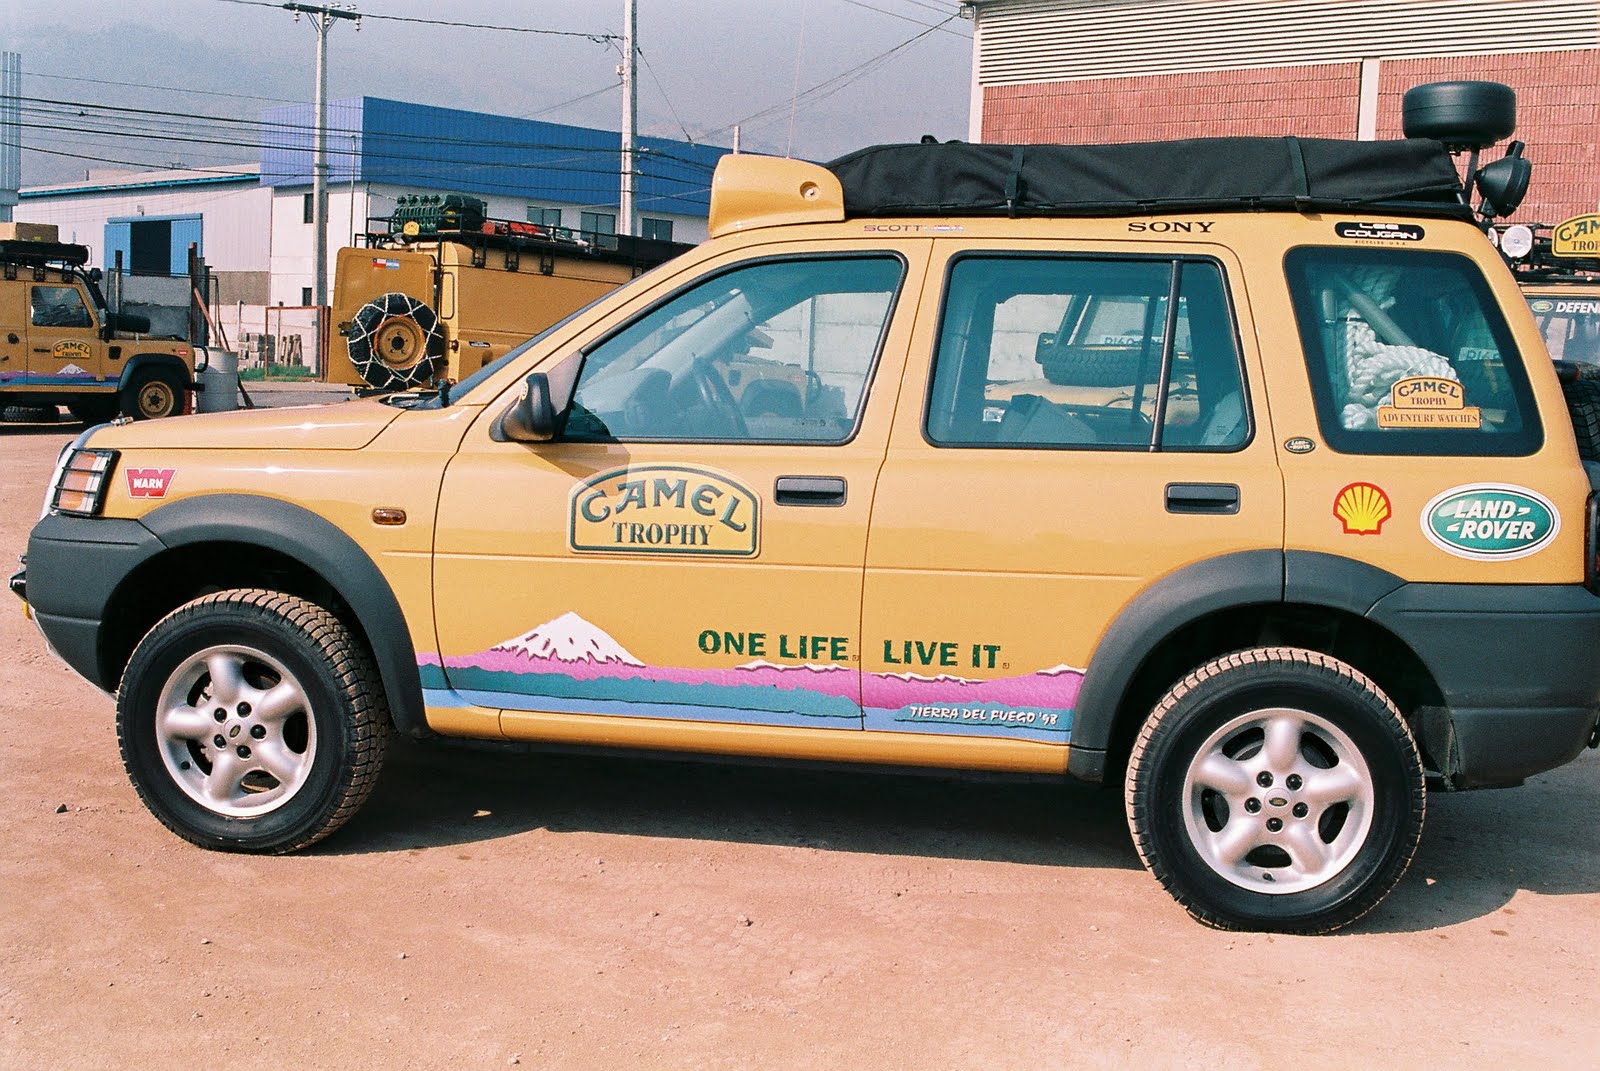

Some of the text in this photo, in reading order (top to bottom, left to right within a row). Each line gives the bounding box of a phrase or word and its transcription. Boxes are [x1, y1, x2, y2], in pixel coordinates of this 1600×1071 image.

[864, 224, 922, 232] SCOTT
[1128, 221, 1215, 233] SONY
[1560, 219, 1600, 241] CAM
[1556, 301, 1600, 314] DEFEN
[55, 342, 89, 355] CAMEL
[1398, 381, 1459, 399] CAMEL
[1411, 397, 1447, 405] TROPHY
[1383, 413, 1477, 423] ADVENTURE WATCHES
[133, 478, 164, 489] WARN
[581, 478, 747, 532] CAMEL
[1454, 500, 1517, 518] LAND
[612, 521, 713, 545] TROPHY
[1460, 521, 1536, 540] ROVER
[698, 629, 1001, 669] ONE LIFE LIVE IT
[909, 706, 1059, 726] TIERRA DEL FUEGO '98
